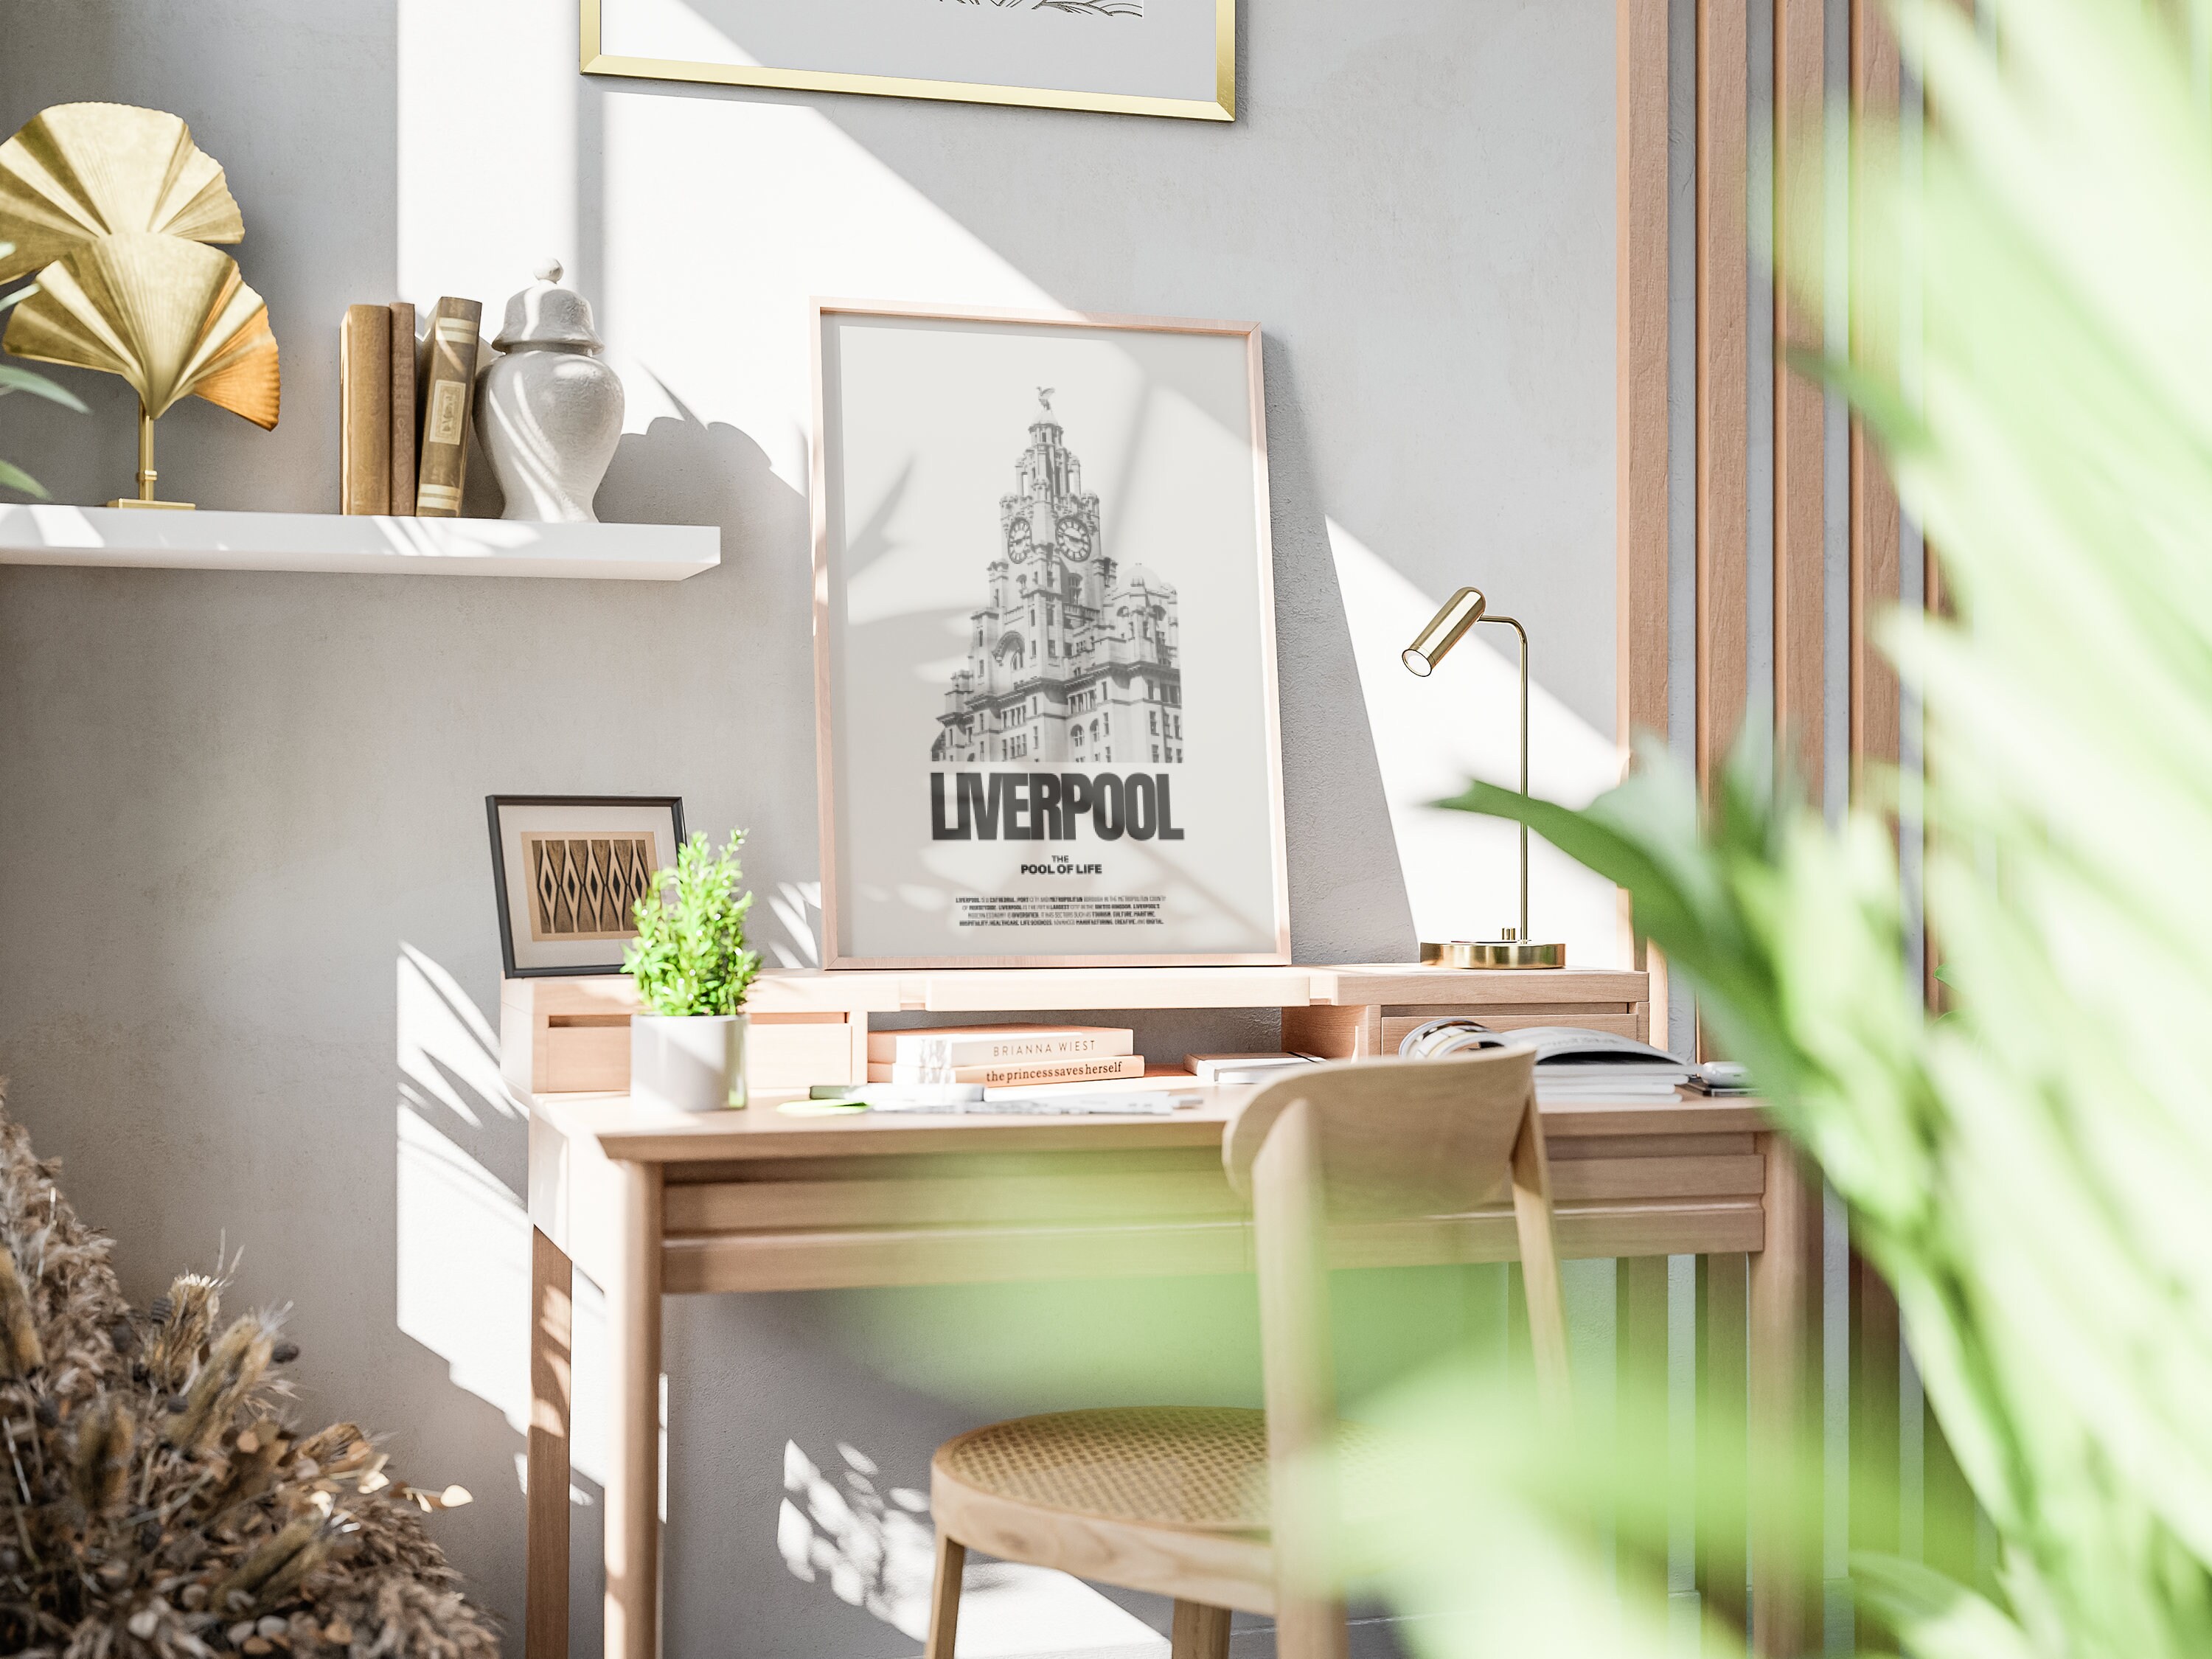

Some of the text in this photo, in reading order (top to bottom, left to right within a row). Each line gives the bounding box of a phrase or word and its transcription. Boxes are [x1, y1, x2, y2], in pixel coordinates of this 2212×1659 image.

[930, 771, 1185, 841] LIVERPOOL
[1051, 855, 1069, 863] THE
[1020, 863, 1102, 874] POOL OF LIFE
[993, 1040, 1096, 1057] BRIANNA WIEST
[987, 1061, 1123, 1083] the princess saves herself
